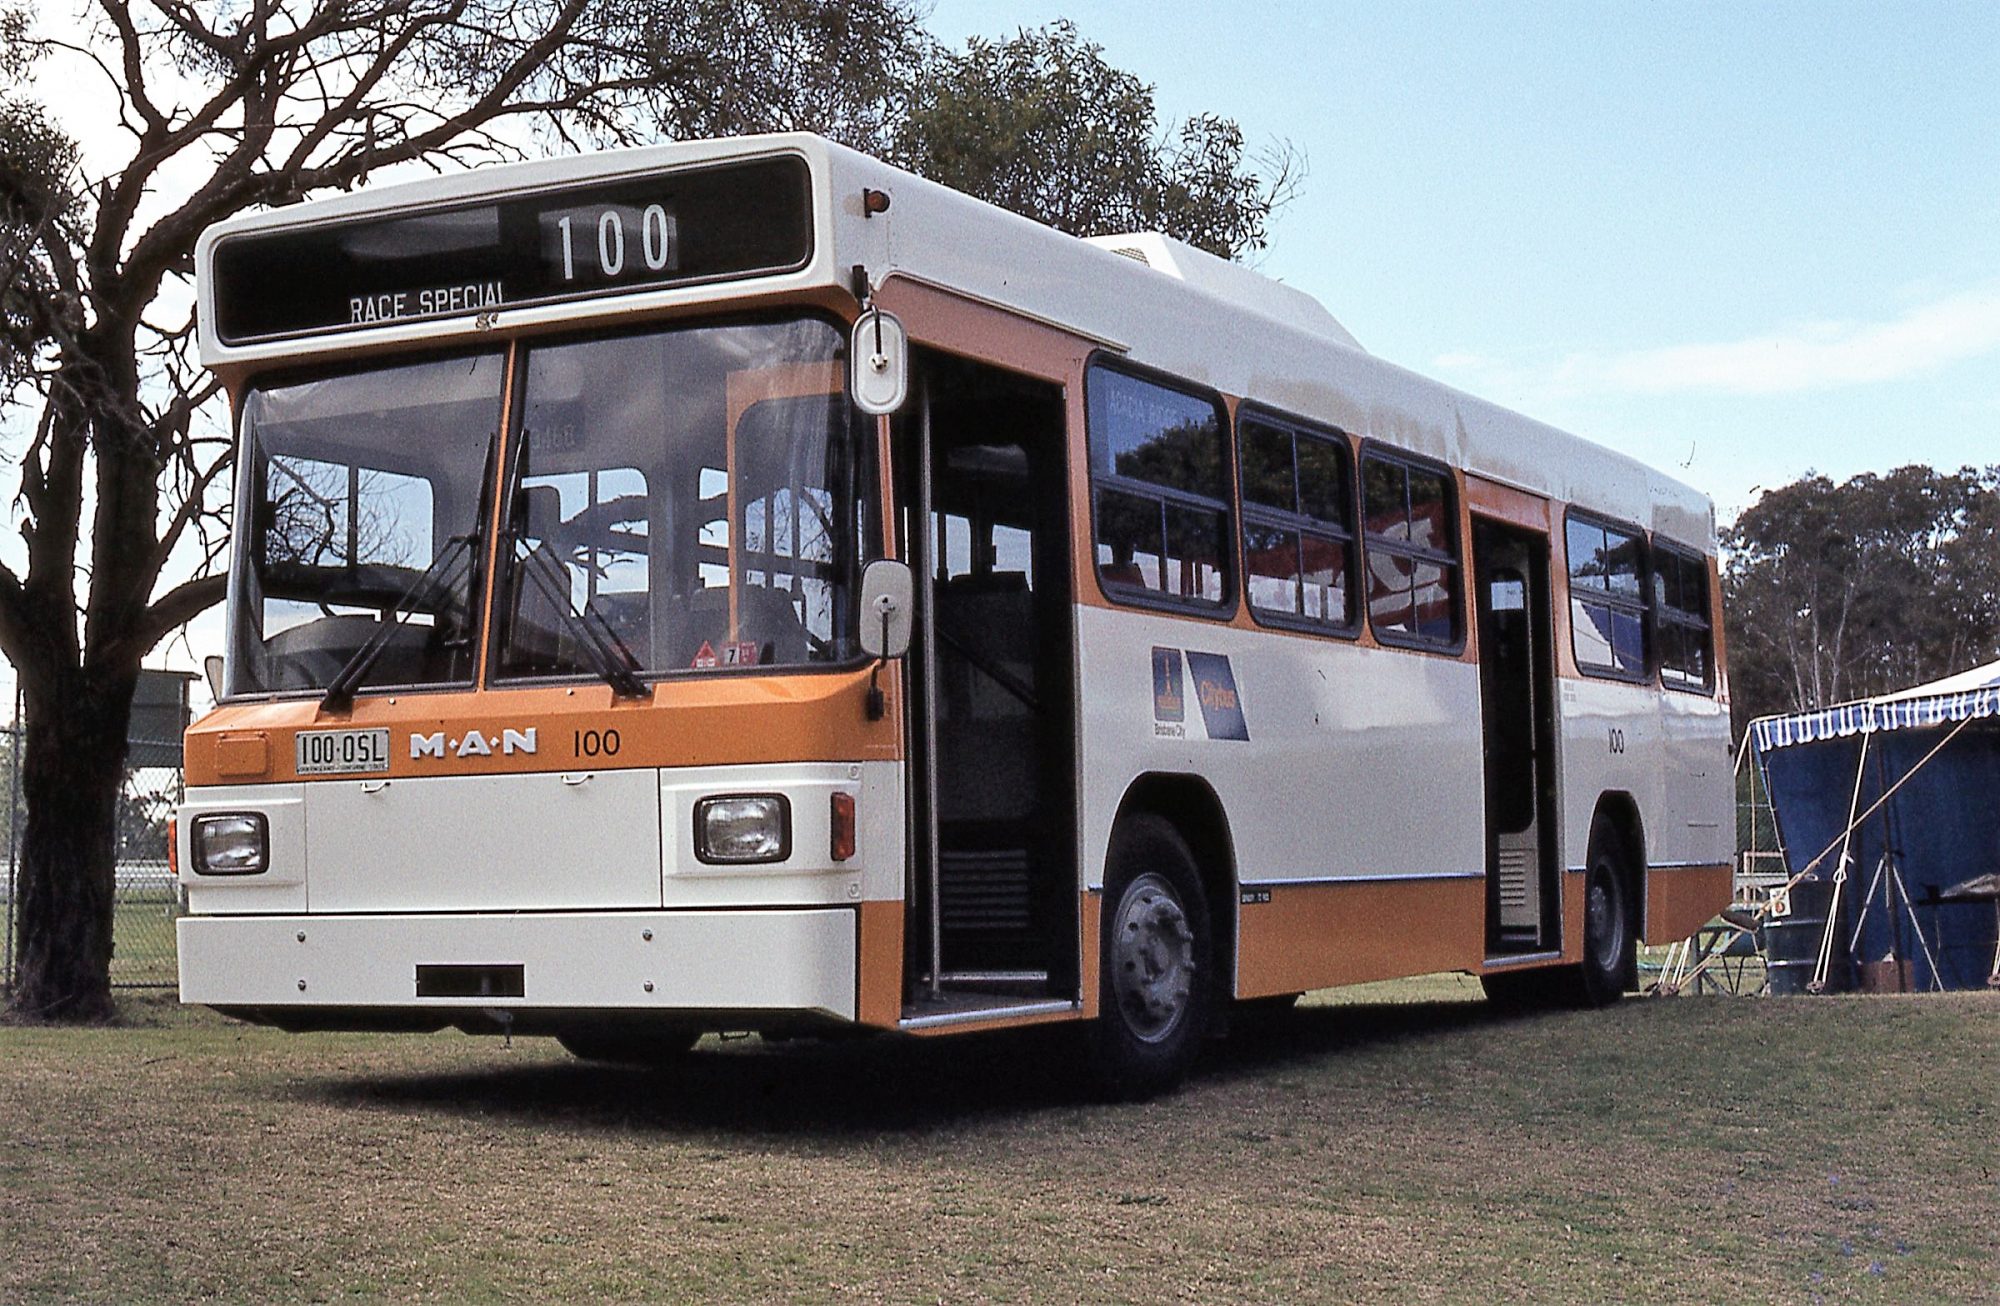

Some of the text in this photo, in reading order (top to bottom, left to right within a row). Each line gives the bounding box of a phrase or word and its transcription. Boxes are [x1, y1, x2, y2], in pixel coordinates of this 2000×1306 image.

[558, 203, 669, 280] 100
[350, 281, 504, 323] RACE SPECIAL
[574, 729, 621, 757] 100
[1608, 727, 1625, 754] 100
